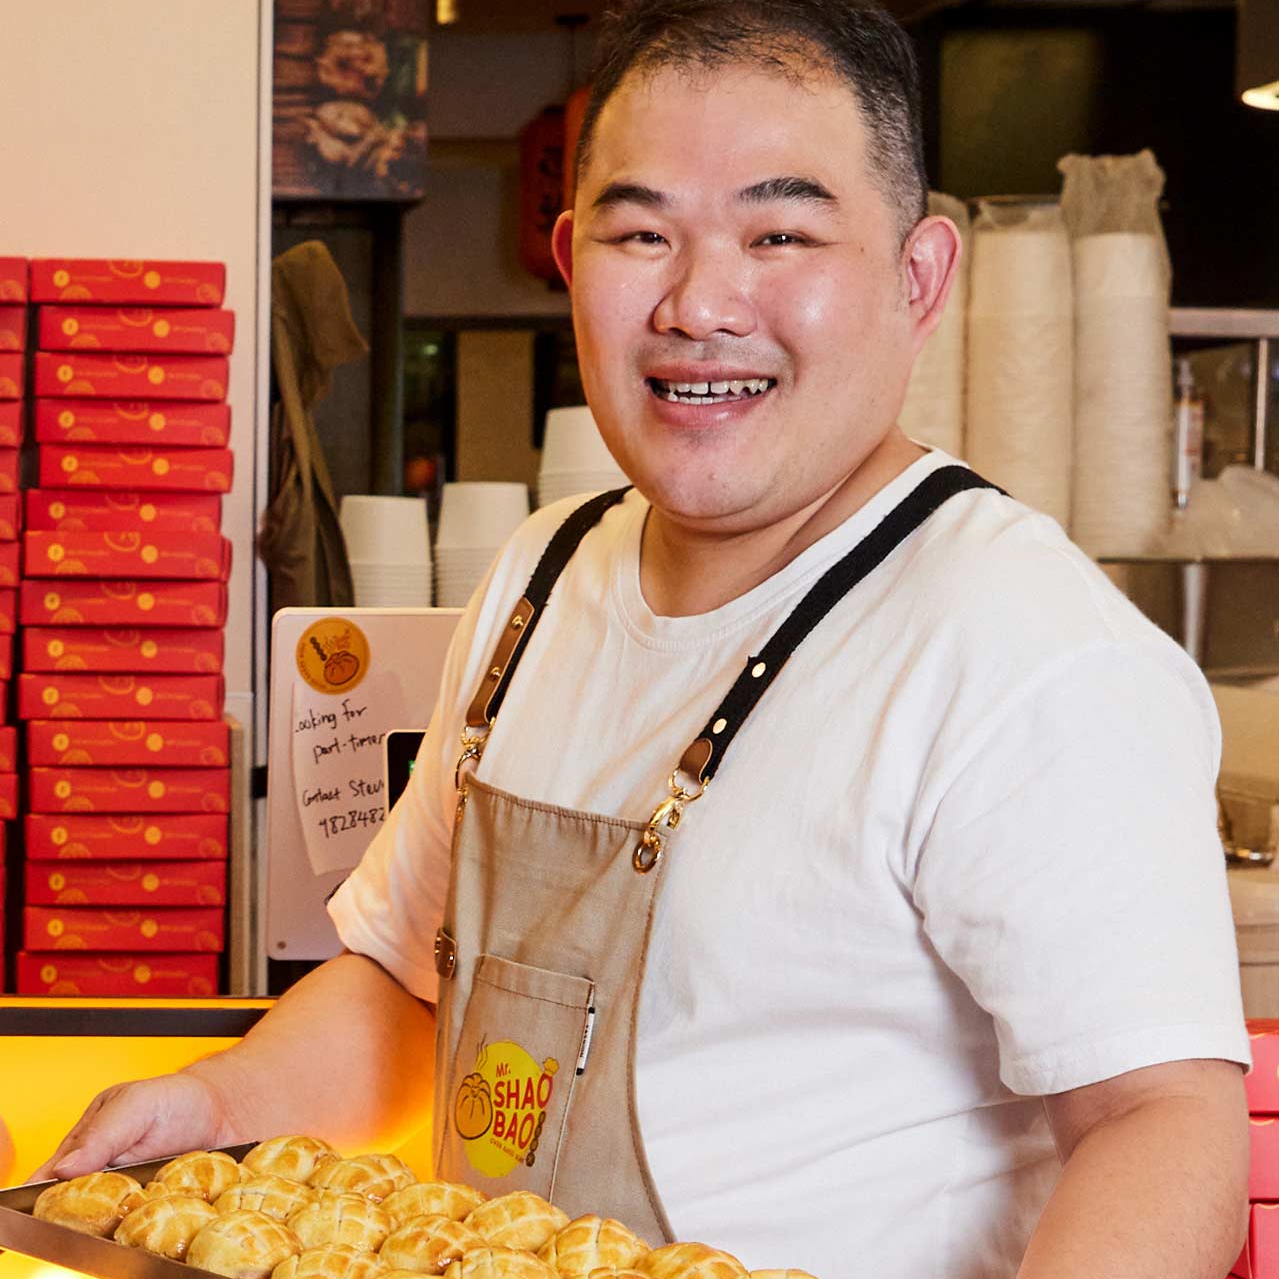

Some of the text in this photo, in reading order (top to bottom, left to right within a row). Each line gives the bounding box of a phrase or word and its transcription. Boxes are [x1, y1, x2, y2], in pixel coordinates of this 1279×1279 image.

[295, 708, 338, 732] ooking
[348, 779, 385, 797] Stev
[493, 1072, 554, 1111] SHAO
[493, 1110, 535, 1150] BAO
